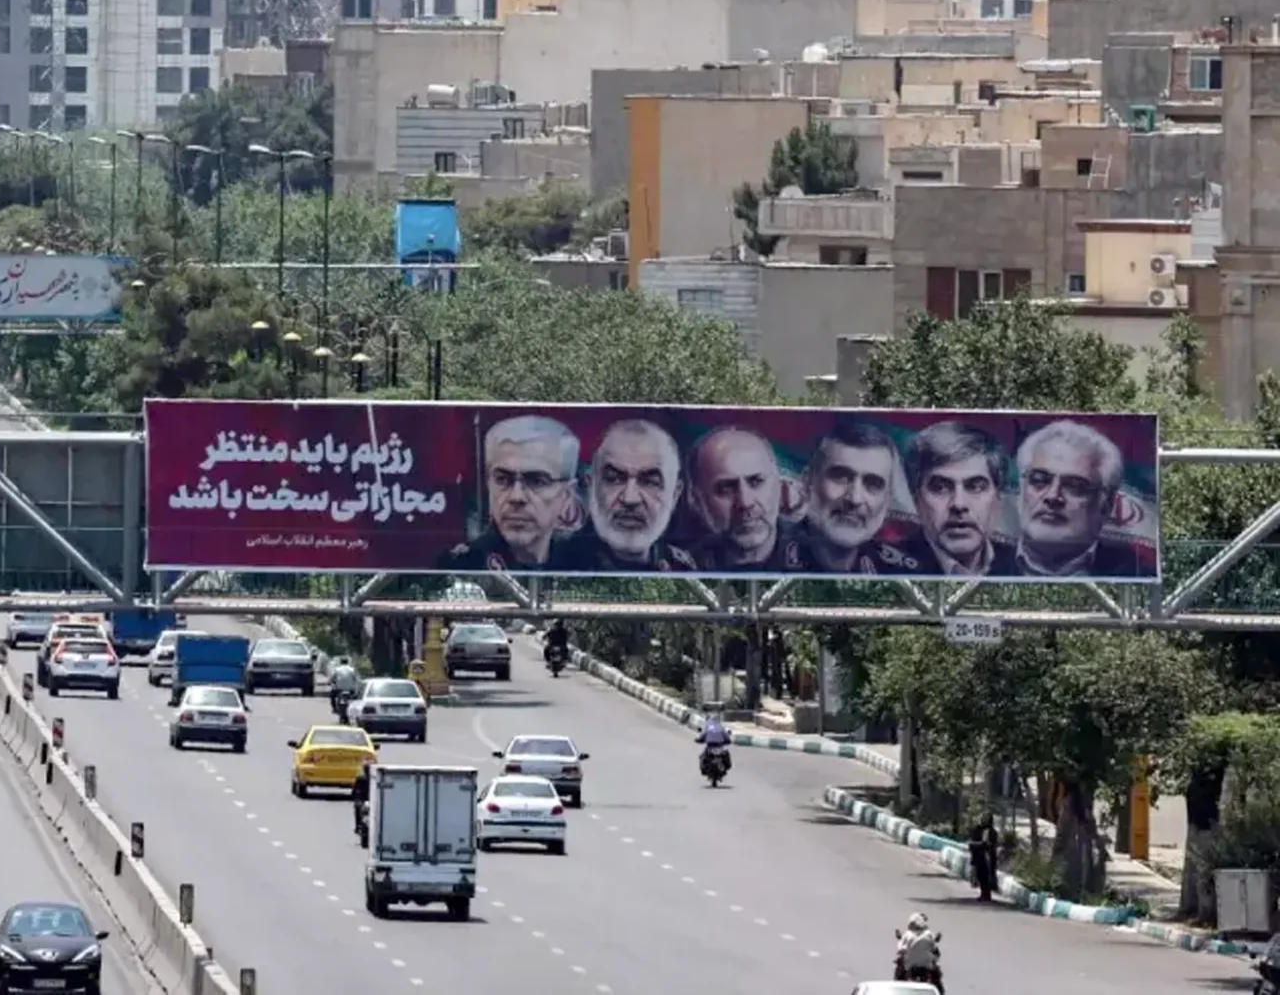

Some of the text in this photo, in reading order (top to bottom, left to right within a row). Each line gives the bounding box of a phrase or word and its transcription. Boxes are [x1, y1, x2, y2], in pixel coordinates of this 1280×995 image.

[199, 430, 413, 474] رژیم باید منتظر
[169, 476, 446, 522] مجازاتی سخت باشد
[245, 534, 370, 550] رهبر معظم انقلاب اسلامی
